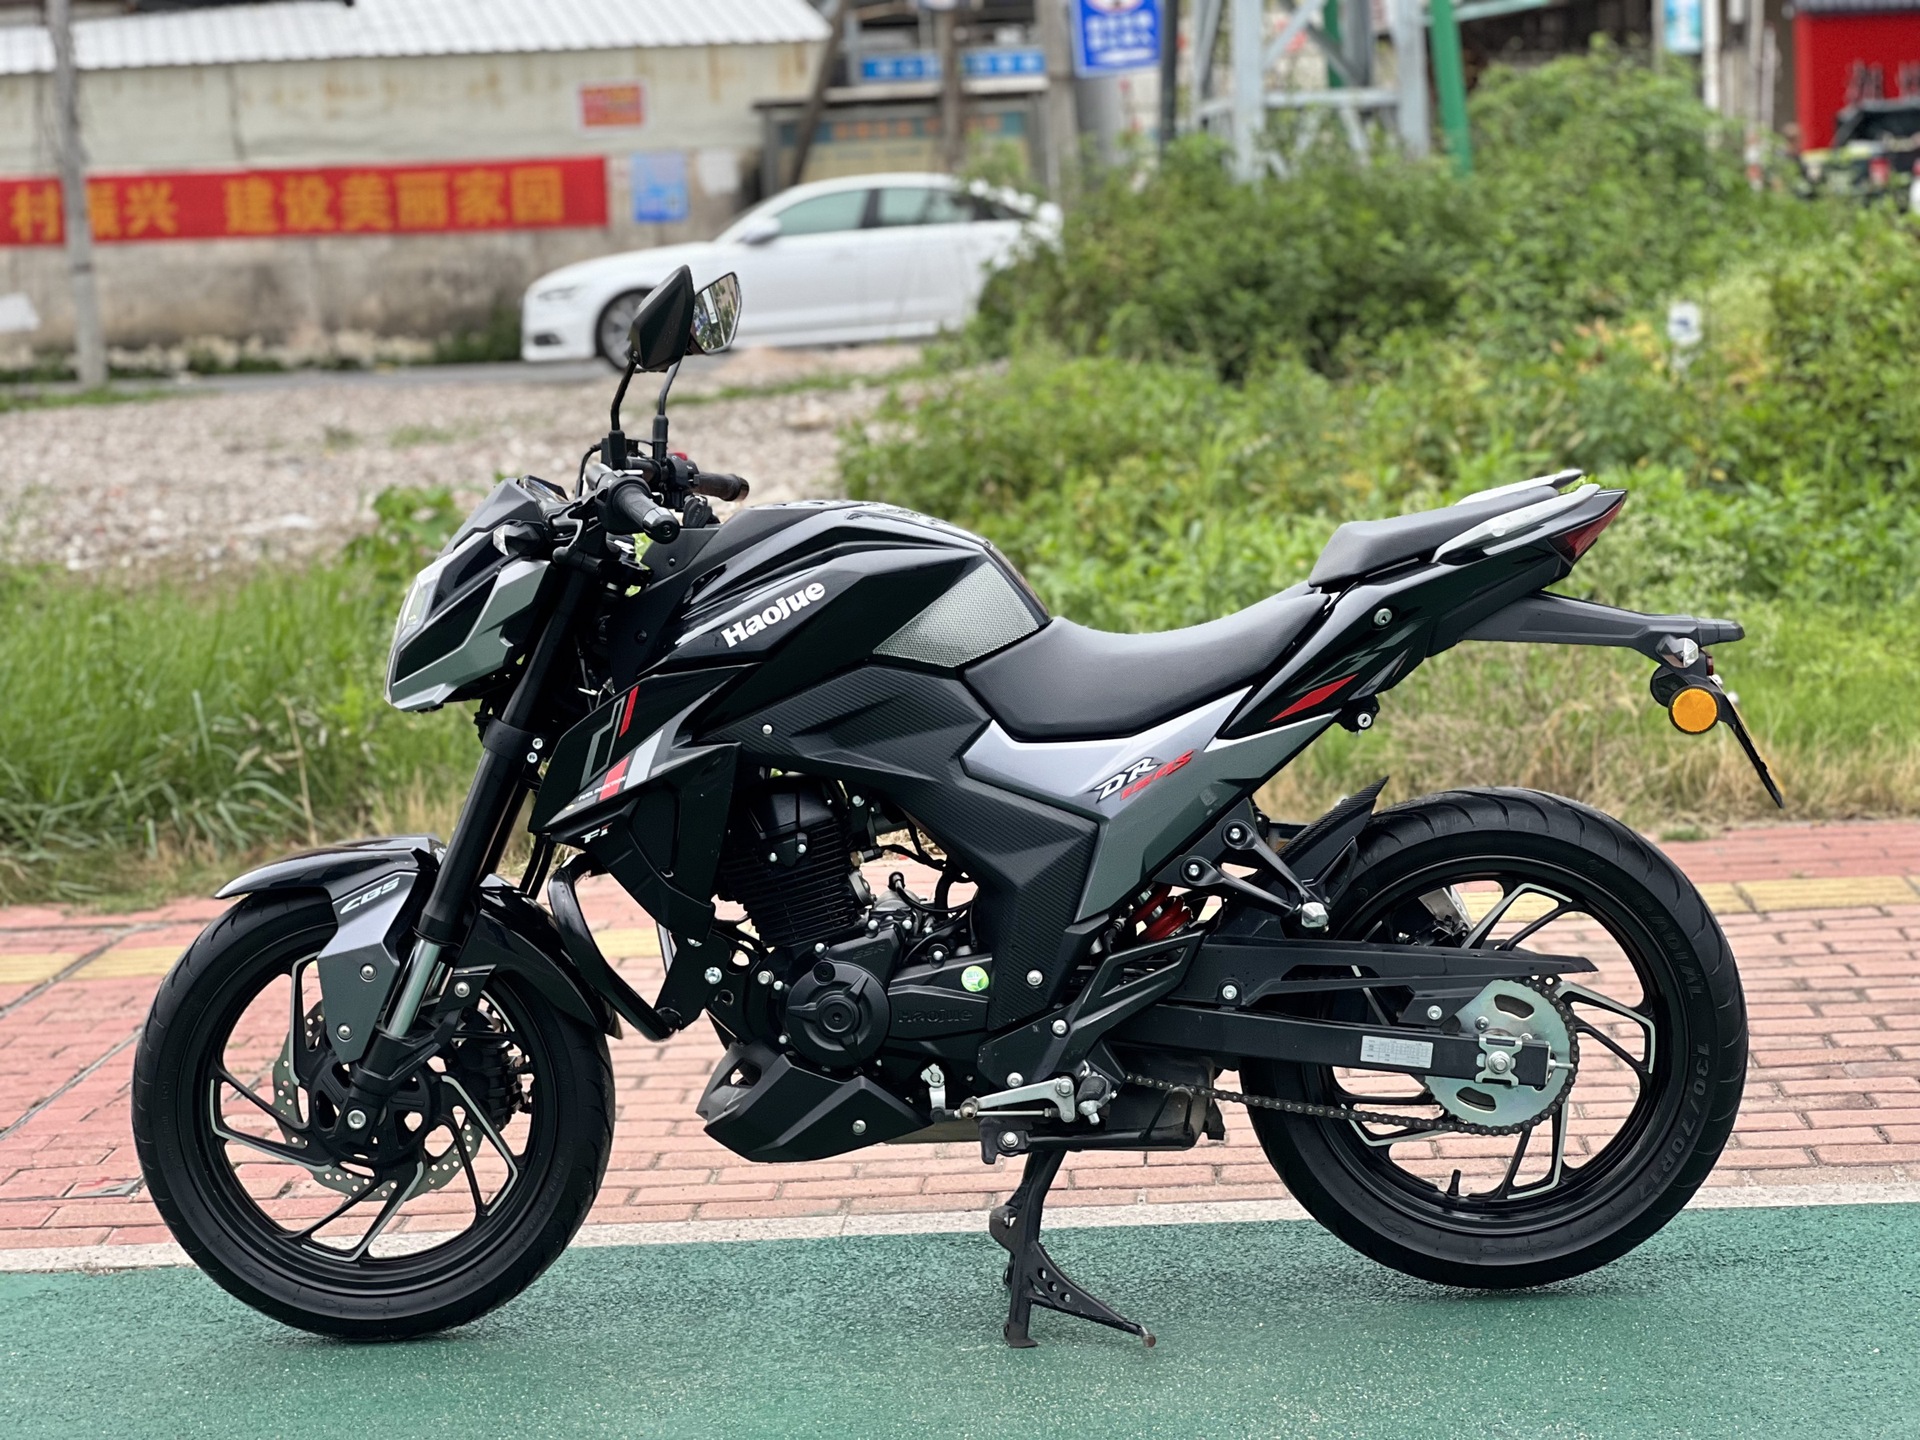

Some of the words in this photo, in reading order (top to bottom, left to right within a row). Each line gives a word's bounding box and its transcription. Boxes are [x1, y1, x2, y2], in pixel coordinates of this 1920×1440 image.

[721, 582, 826, 648] Haojue
[1090, 757, 1161, 803] DR
[340, 877, 400, 915] CBS
[1638, 1043, 1711, 1200] 130/70R17
